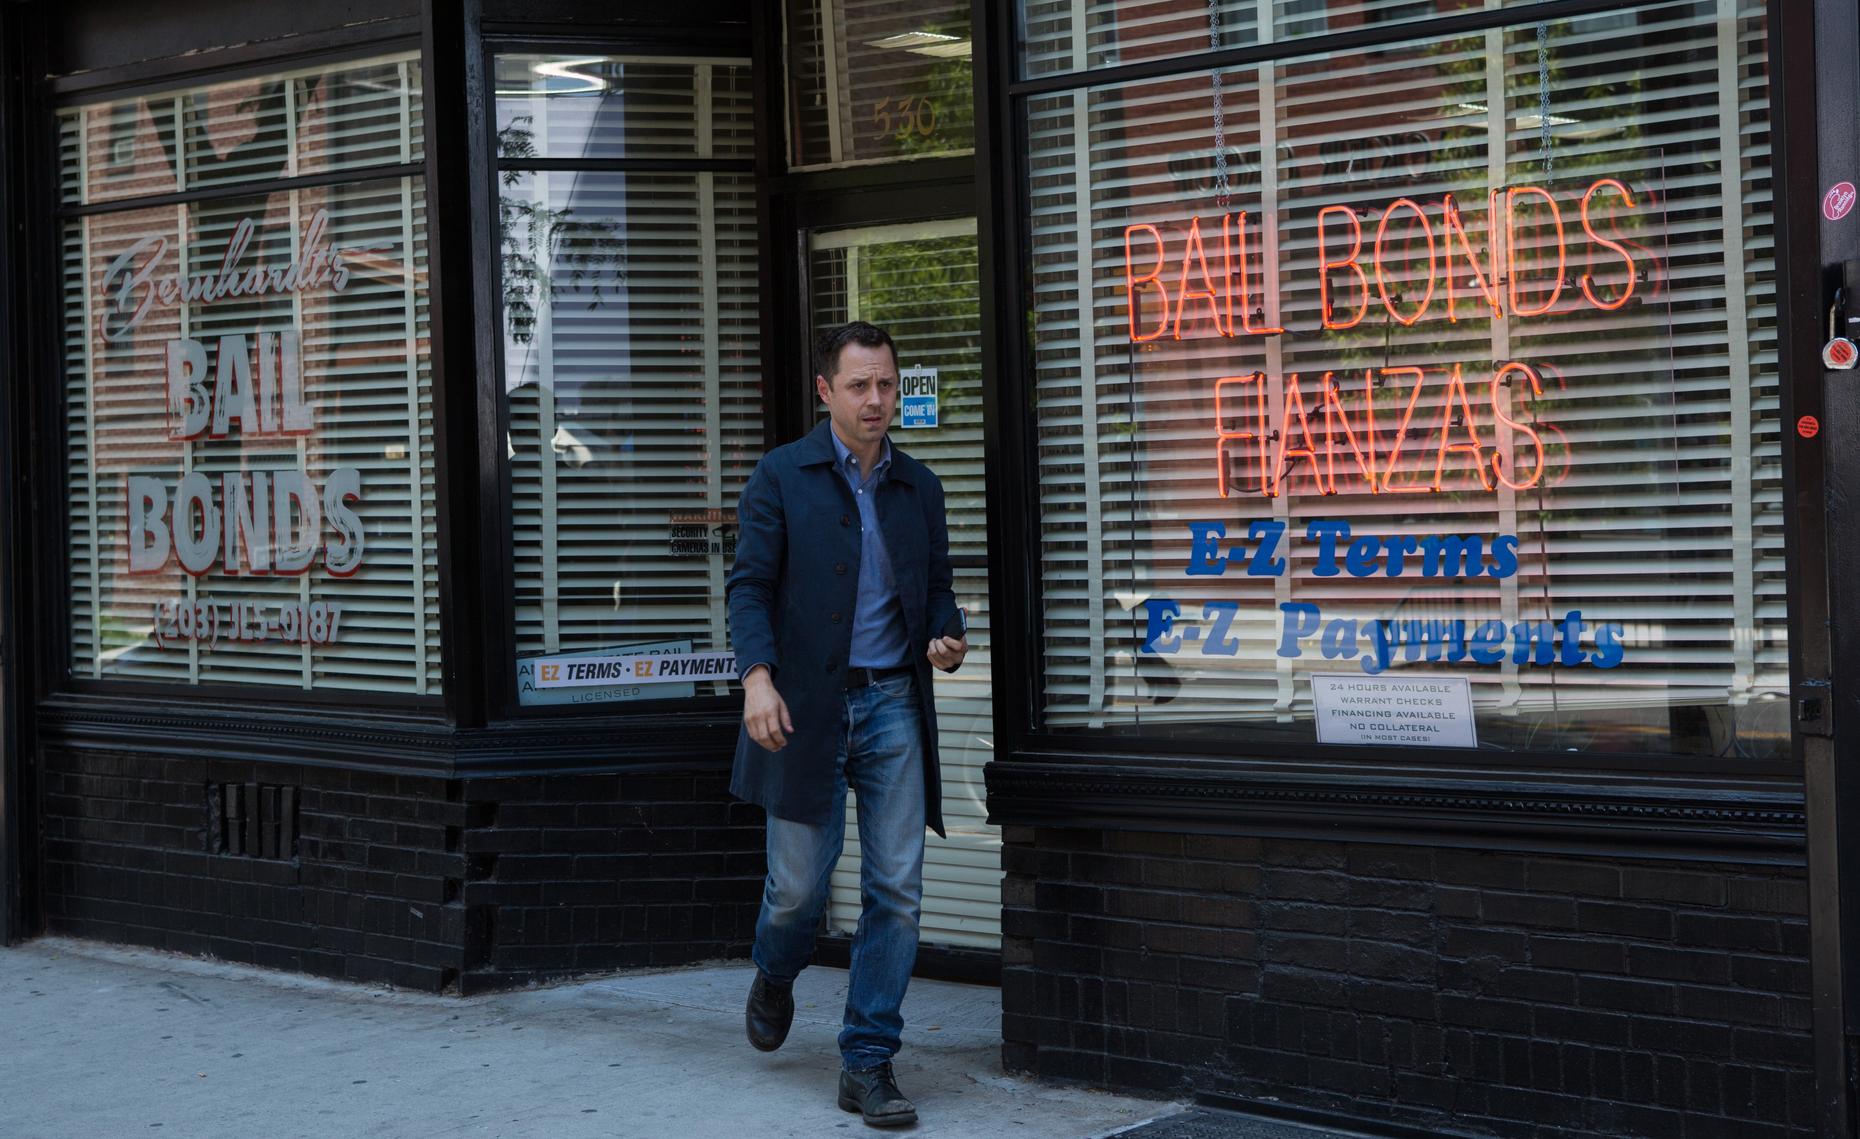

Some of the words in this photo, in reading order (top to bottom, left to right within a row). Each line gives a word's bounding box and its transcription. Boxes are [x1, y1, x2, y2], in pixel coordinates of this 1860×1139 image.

[872, 96, 936, 141] 530
[1124, 210, 1285, 342] BAIL
[1317, 179, 1636, 331] BONDS
[101, 208, 394, 343] Bernhardt's
[165, 330, 314, 441] BAIL
[902, 375, 936, 396] OPEN
[904, 405, 926, 417] COME
[927, 403, 936, 416] IN
[1214, 361, 1545, 498] FIANZAS
[126, 468, 366, 577] BONDS
[671, 526, 709, 538] SECURITY
[711, 542, 721, 553] IN
[1185, 520, 1287, 577] E-Z
[1306, 520, 1519, 579] Terms
[1140, 598, 1240, 656] E-Z
[1276, 600, 1625, 675] Payments
[541, 664, 561, 682] EZ
[567, 661, 623, 680] TERMS
[634, 660, 654, 678] EZ
[658, 657, 738, 677] PAYMENT
[572, 687, 641, 703] LICENSED
[1330, 683, 1344, 691] 24
[1348, 684, 1388, 692] HOURS
[1391, 684, 1451, 693] AVAILABLE
[1340, 697, 1393, 705] WARRANT
[1396, 698, 1443, 706] CHECKS
[1331, 709, 1392, 718] FINANCING
[1396, 711, 1457, 720] AVAILABLE
[1370, 723, 1440, 733] COLLATERAL
